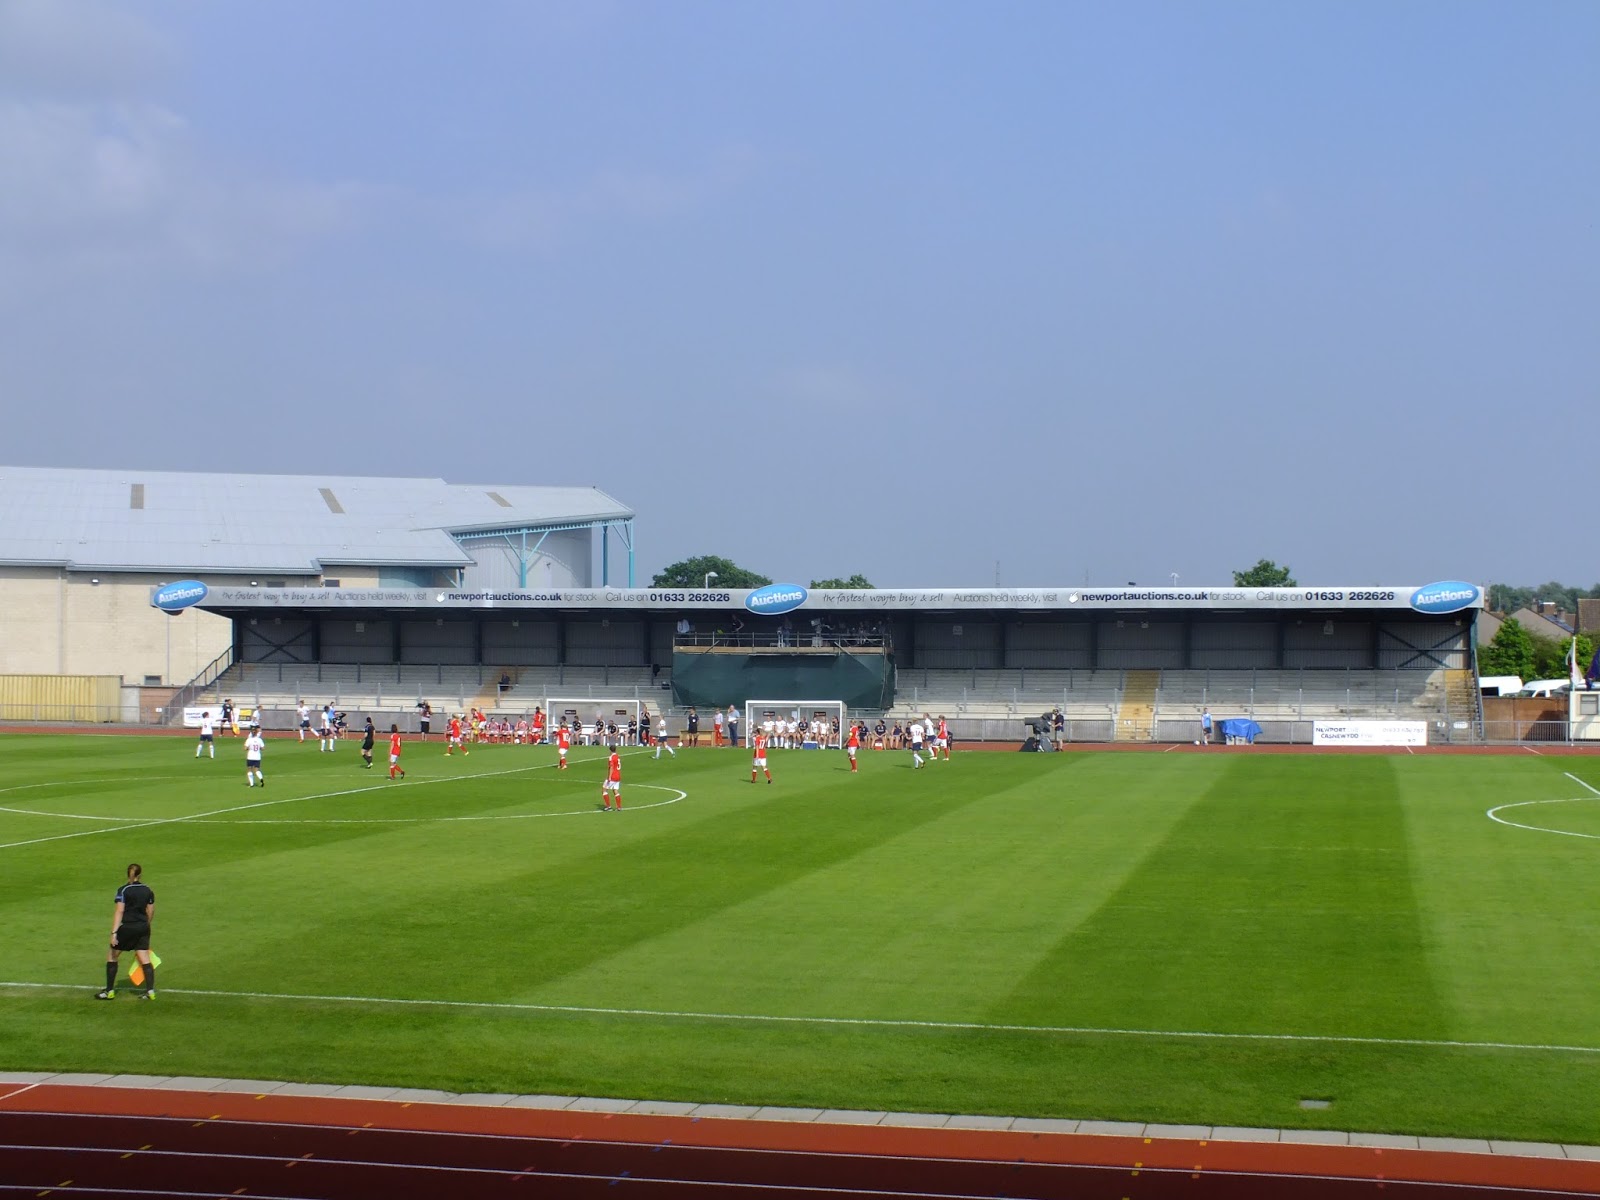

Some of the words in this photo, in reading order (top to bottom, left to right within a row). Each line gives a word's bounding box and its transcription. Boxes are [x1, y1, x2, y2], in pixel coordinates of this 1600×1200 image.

[158, 586, 204, 604] Auctions
[222, 591, 234, 600] the
[235, 591, 261, 603] fastest
[263, 592, 281, 603] way
[282, 592, 290, 600] to
[291, 591, 307, 603] buy
[309, 592, 316, 600] &
[317, 591, 330, 600] sell
[335, 592, 366, 600] Auctions
[367, 592, 384, 600] held
[385, 592, 412, 603] weekly,
[413, 592, 427, 601] visit
[448, 592, 562, 602] newportauctions.co.uk
[564, 592, 574, 601] for
[575, 592, 597, 601] stock
[605, 592, 620, 602] Call
[622, 593, 634, 602] us
[636, 594, 648, 602] on
[650, 593, 685, 602] 01633
[688, 593, 730, 602] 262626
[750, 590, 802, 607] Auctions
[823, 593, 835, 602] the
[835, 592, 867, 604] fastest
[869, 595, 887, 606] way
[899, 592, 917, 605] buy
[920, 594, 927, 602] &
[929, 592, 943, 602] sell
[953, 593, 989, 602] Auctions
[990, 592, 1009, 602] held
[1009, 592, 1041, 604] weekly,
[1042, 593, 1057, 602] visit
[1081, 592, 1208, 602] newportauctions.co.uk
[1210, 592, 1221, 601] for
[1222, 592, 1246, 601] stock
[1256, 592, 1274, 601] Call
[1275, 593, 1290, 602] us
[1305, 592, 1343, 601] 01633
[1349, 592, 1395, 601] 262626
[1416, 588, 1473, 606] Auctions
[562, 732, 570, 741] 10
[759, 739, 765, 748] 17
